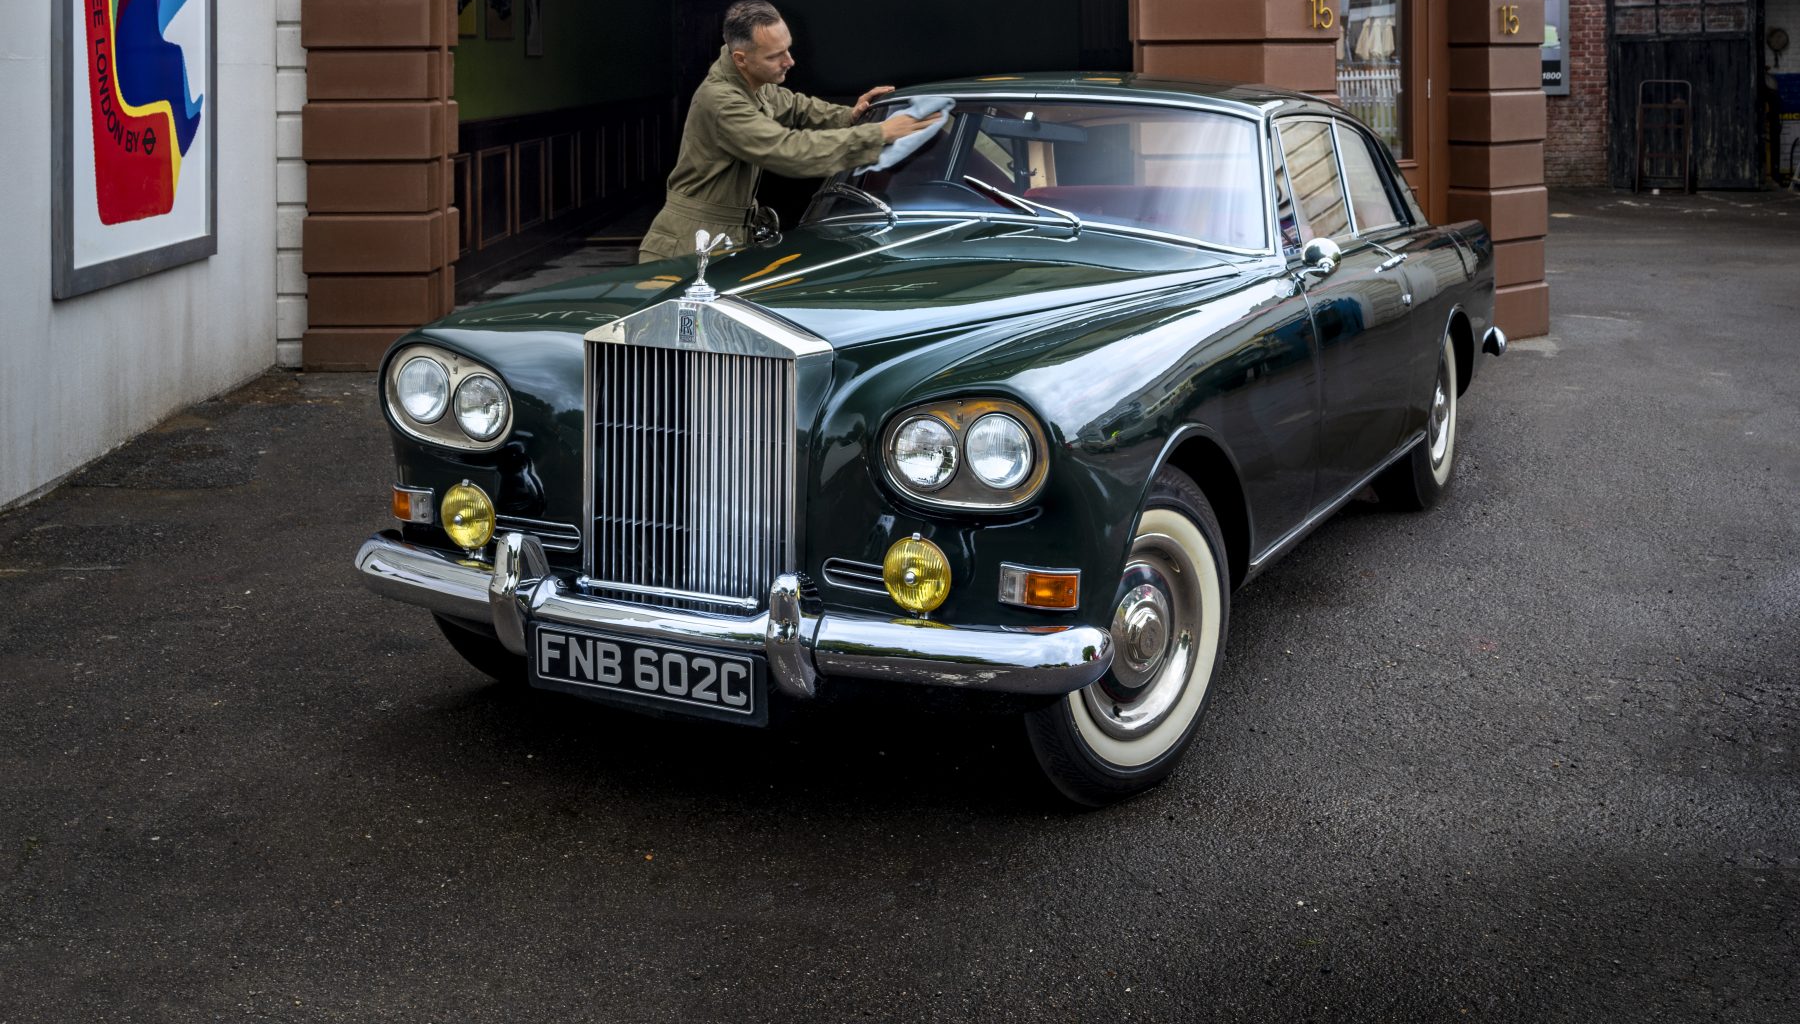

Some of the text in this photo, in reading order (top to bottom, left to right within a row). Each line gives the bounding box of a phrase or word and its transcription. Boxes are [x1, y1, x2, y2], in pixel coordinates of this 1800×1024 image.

[1501, 5, 1520, 35] 15
[95, 38, 124, 146] LONDON
[125, 130, 141, 153] BY
[541, 633, 748, 706] FNB 602C
